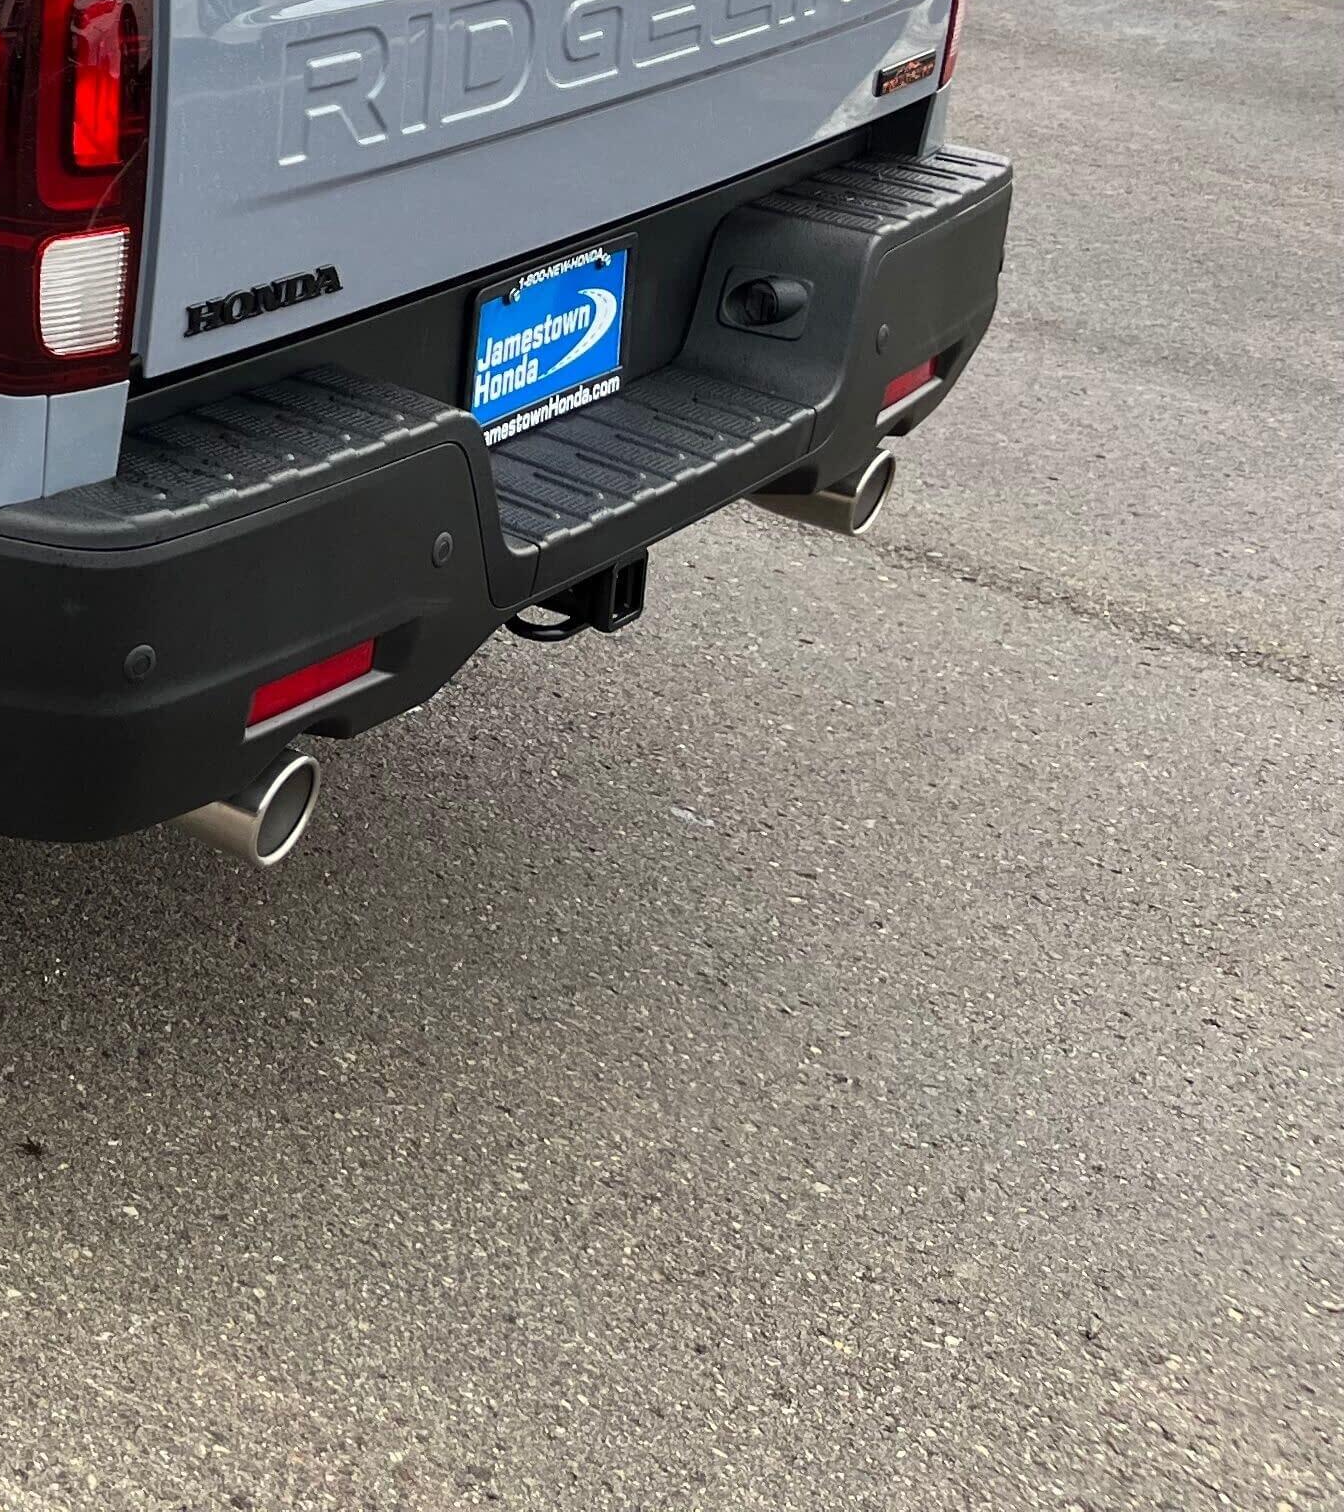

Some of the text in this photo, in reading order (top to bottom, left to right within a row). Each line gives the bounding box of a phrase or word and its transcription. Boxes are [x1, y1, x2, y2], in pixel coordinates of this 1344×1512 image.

[183, 263, 344, 338] HONDA
[477, 303, 591, 372] Jamestown
[473, 355, 540, 408] Honda
[483, 374, 621, 447] amestownHonda.com
